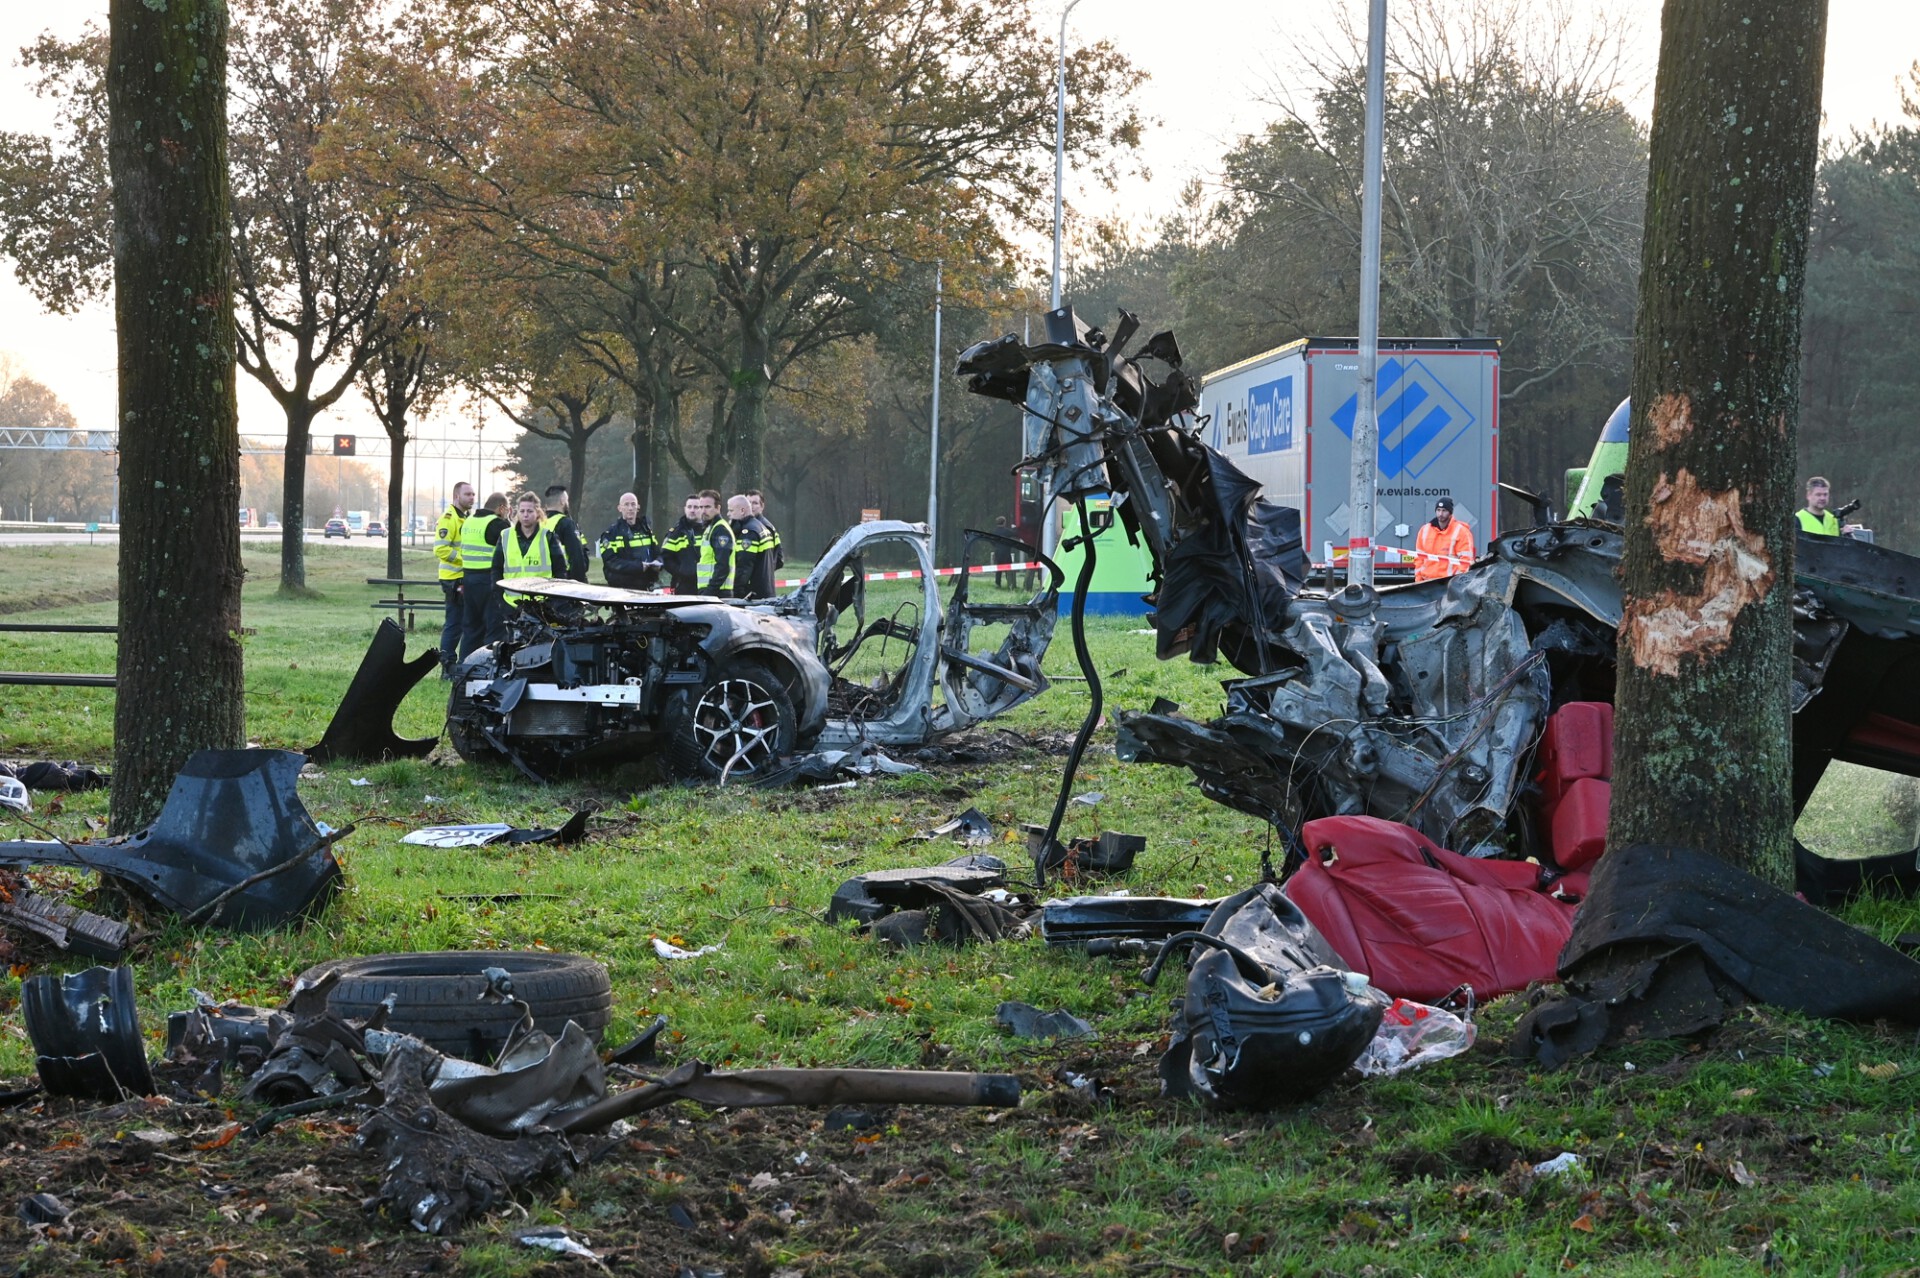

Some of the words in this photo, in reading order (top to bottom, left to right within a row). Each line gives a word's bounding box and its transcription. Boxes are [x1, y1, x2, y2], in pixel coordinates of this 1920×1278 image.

[1227, 398, 1248, 445] Ewals
[1249, 393, 1271, 450] Cargo
[1272, 387, 1291, 437] Care
[1376, 486, 1450, 496] w.ewals.com
